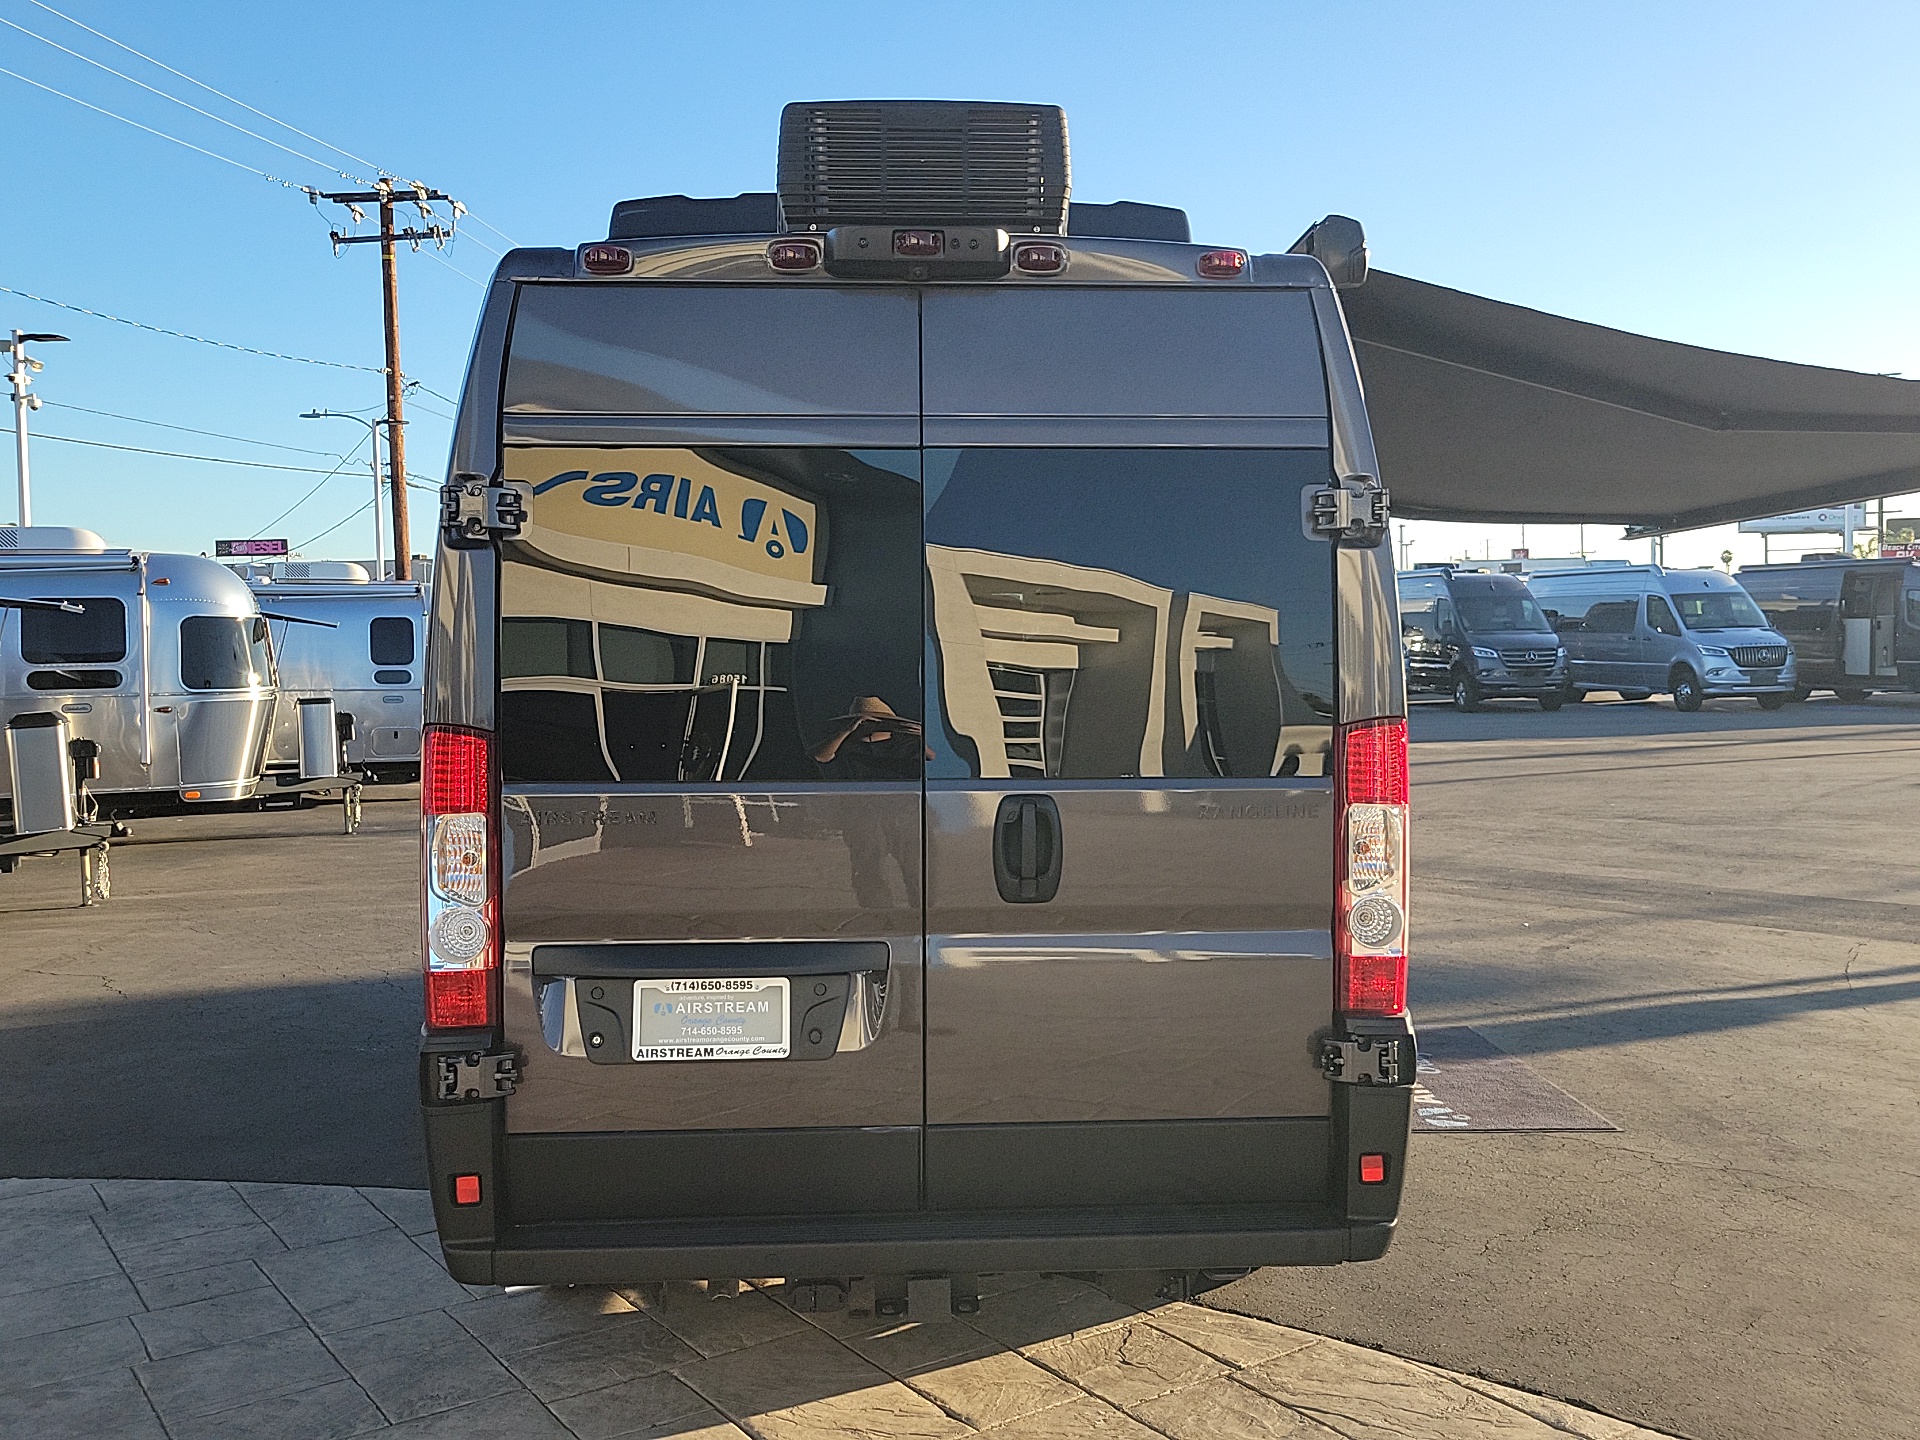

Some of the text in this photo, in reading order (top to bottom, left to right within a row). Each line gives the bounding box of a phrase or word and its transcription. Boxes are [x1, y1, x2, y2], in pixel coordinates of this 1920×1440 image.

[1199, 804, 1320, 820] RANGELINE
[675, 1001, 769, 1014] AIRSTREAM
[716, 1015, 746, 1026] County
[681, 1026, 743, 1036] 714-650-8595
[658, 1036, 765, 1044] www.airstreamorangecounty.com
[636, 1045, 788, 1059] AIRSTREAM Orange County
